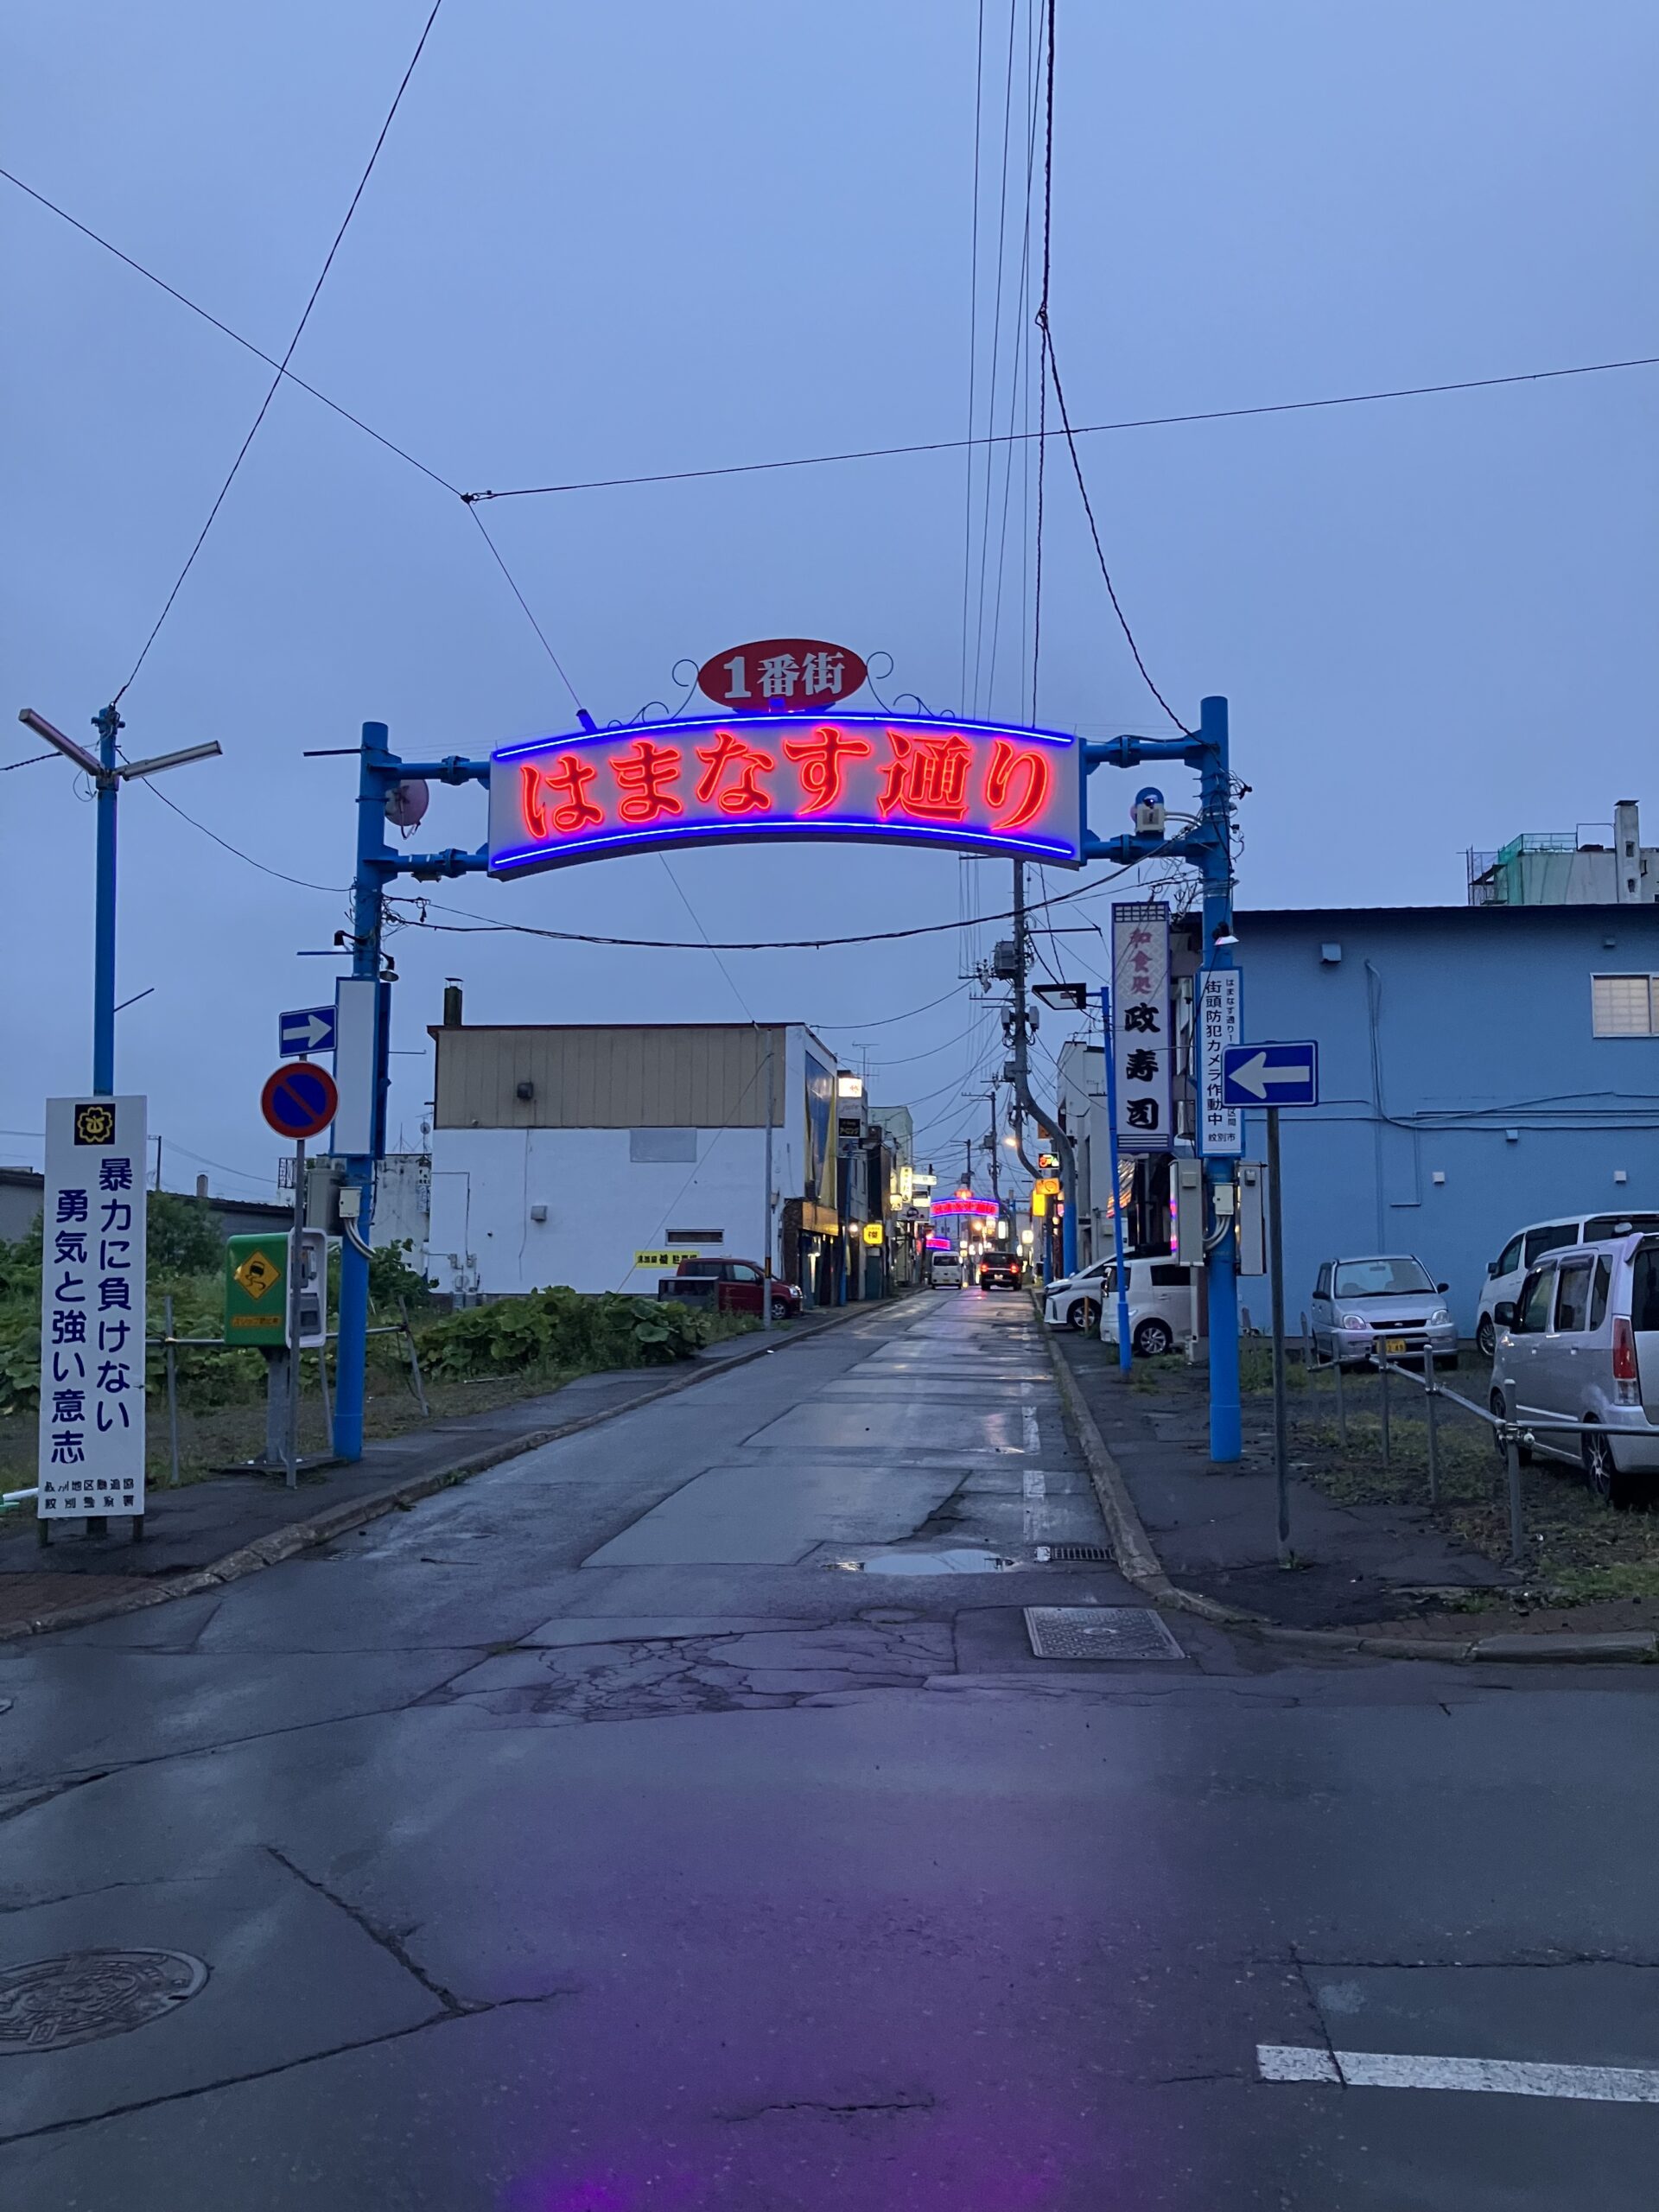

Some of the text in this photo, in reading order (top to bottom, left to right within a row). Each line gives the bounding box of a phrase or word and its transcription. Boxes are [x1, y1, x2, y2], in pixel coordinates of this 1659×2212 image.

[722, 652, 846, 699] 1番街
[520, 726, 1050, 840] はまなす通り
[1128, 927, 1153, 995] 和食処
[1124, 1002, 1161, 1130] 政寿司
[1205, 980, 1223, 1127] 街頭防犯カメラ作動中
[1207, 1133, 1236, 1142] 紋別市
[51, 1189, 88, 1464] 勇気と強い意志
[96, 1158, 133, 1432] 暴力に負けない
